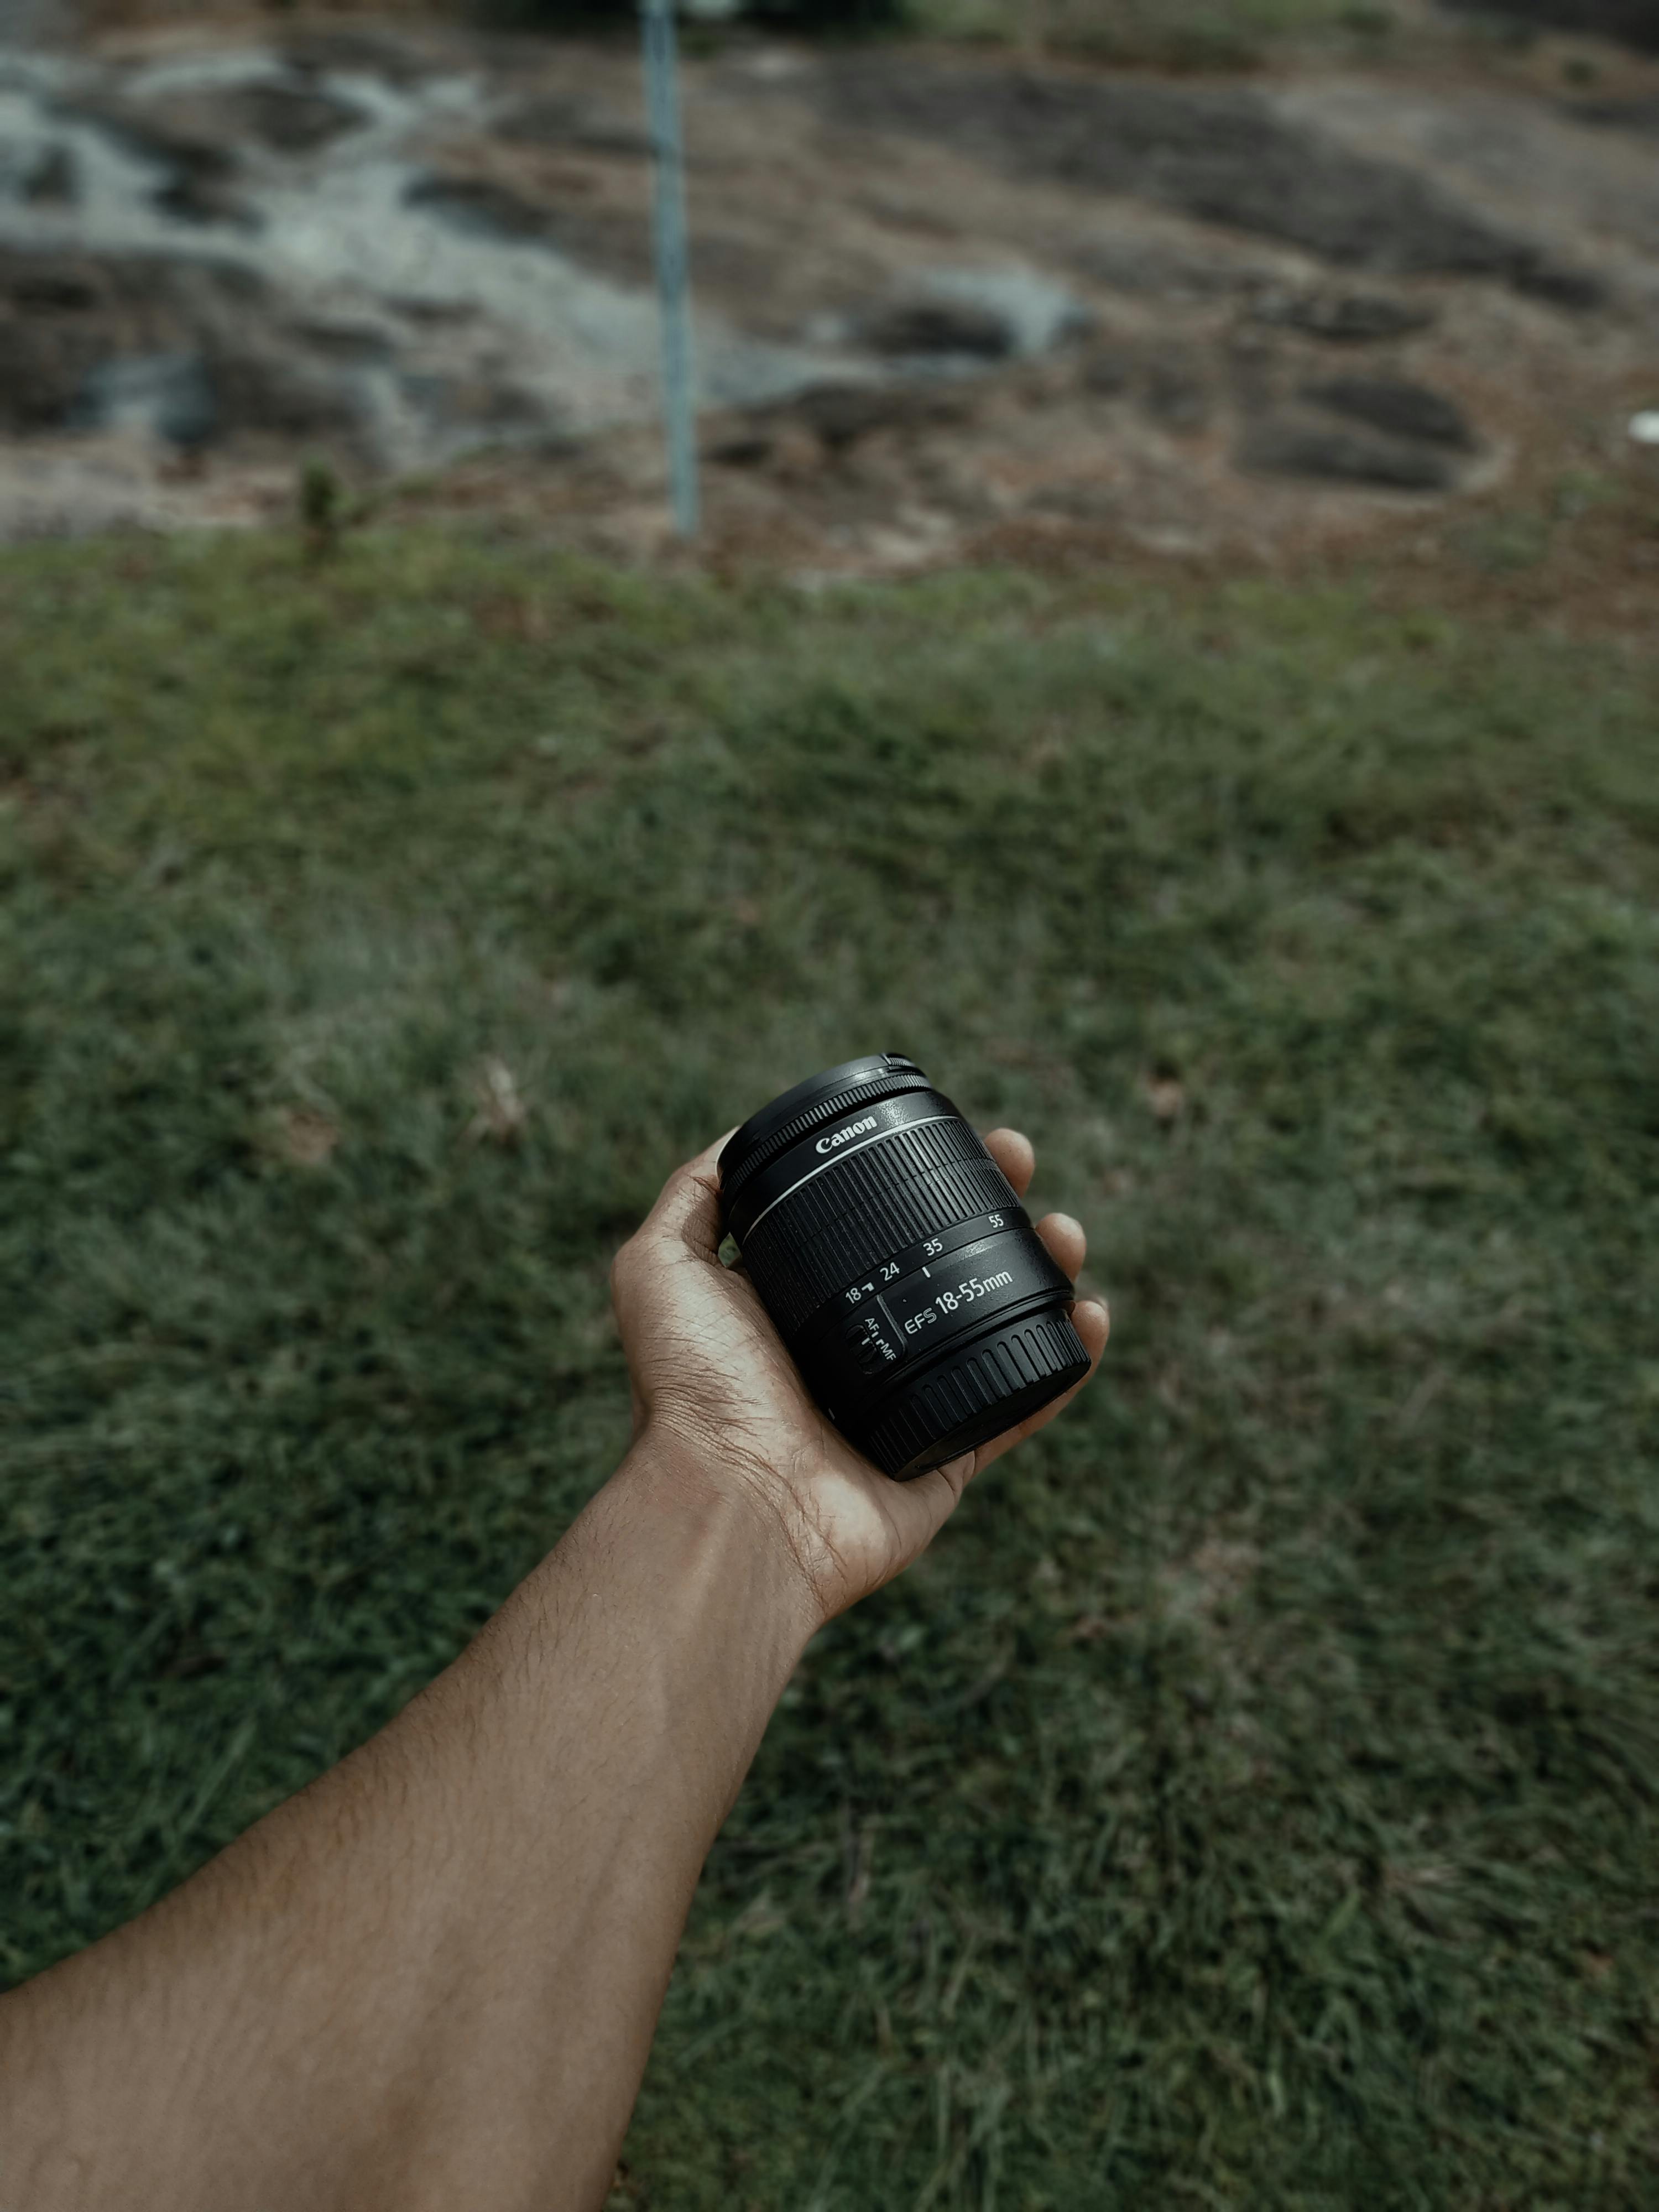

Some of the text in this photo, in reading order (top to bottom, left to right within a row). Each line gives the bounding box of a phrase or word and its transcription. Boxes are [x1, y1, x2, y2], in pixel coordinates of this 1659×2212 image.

[816, 1116, 877, 1154] Canon
[846, 1214, 1004, 1304] 18 24 35 55
[935, 1271, 1013, 1314] 18-55mm
[865, 1318, 879, 1331] AF
[880, 1343, 896, 1360] MF
